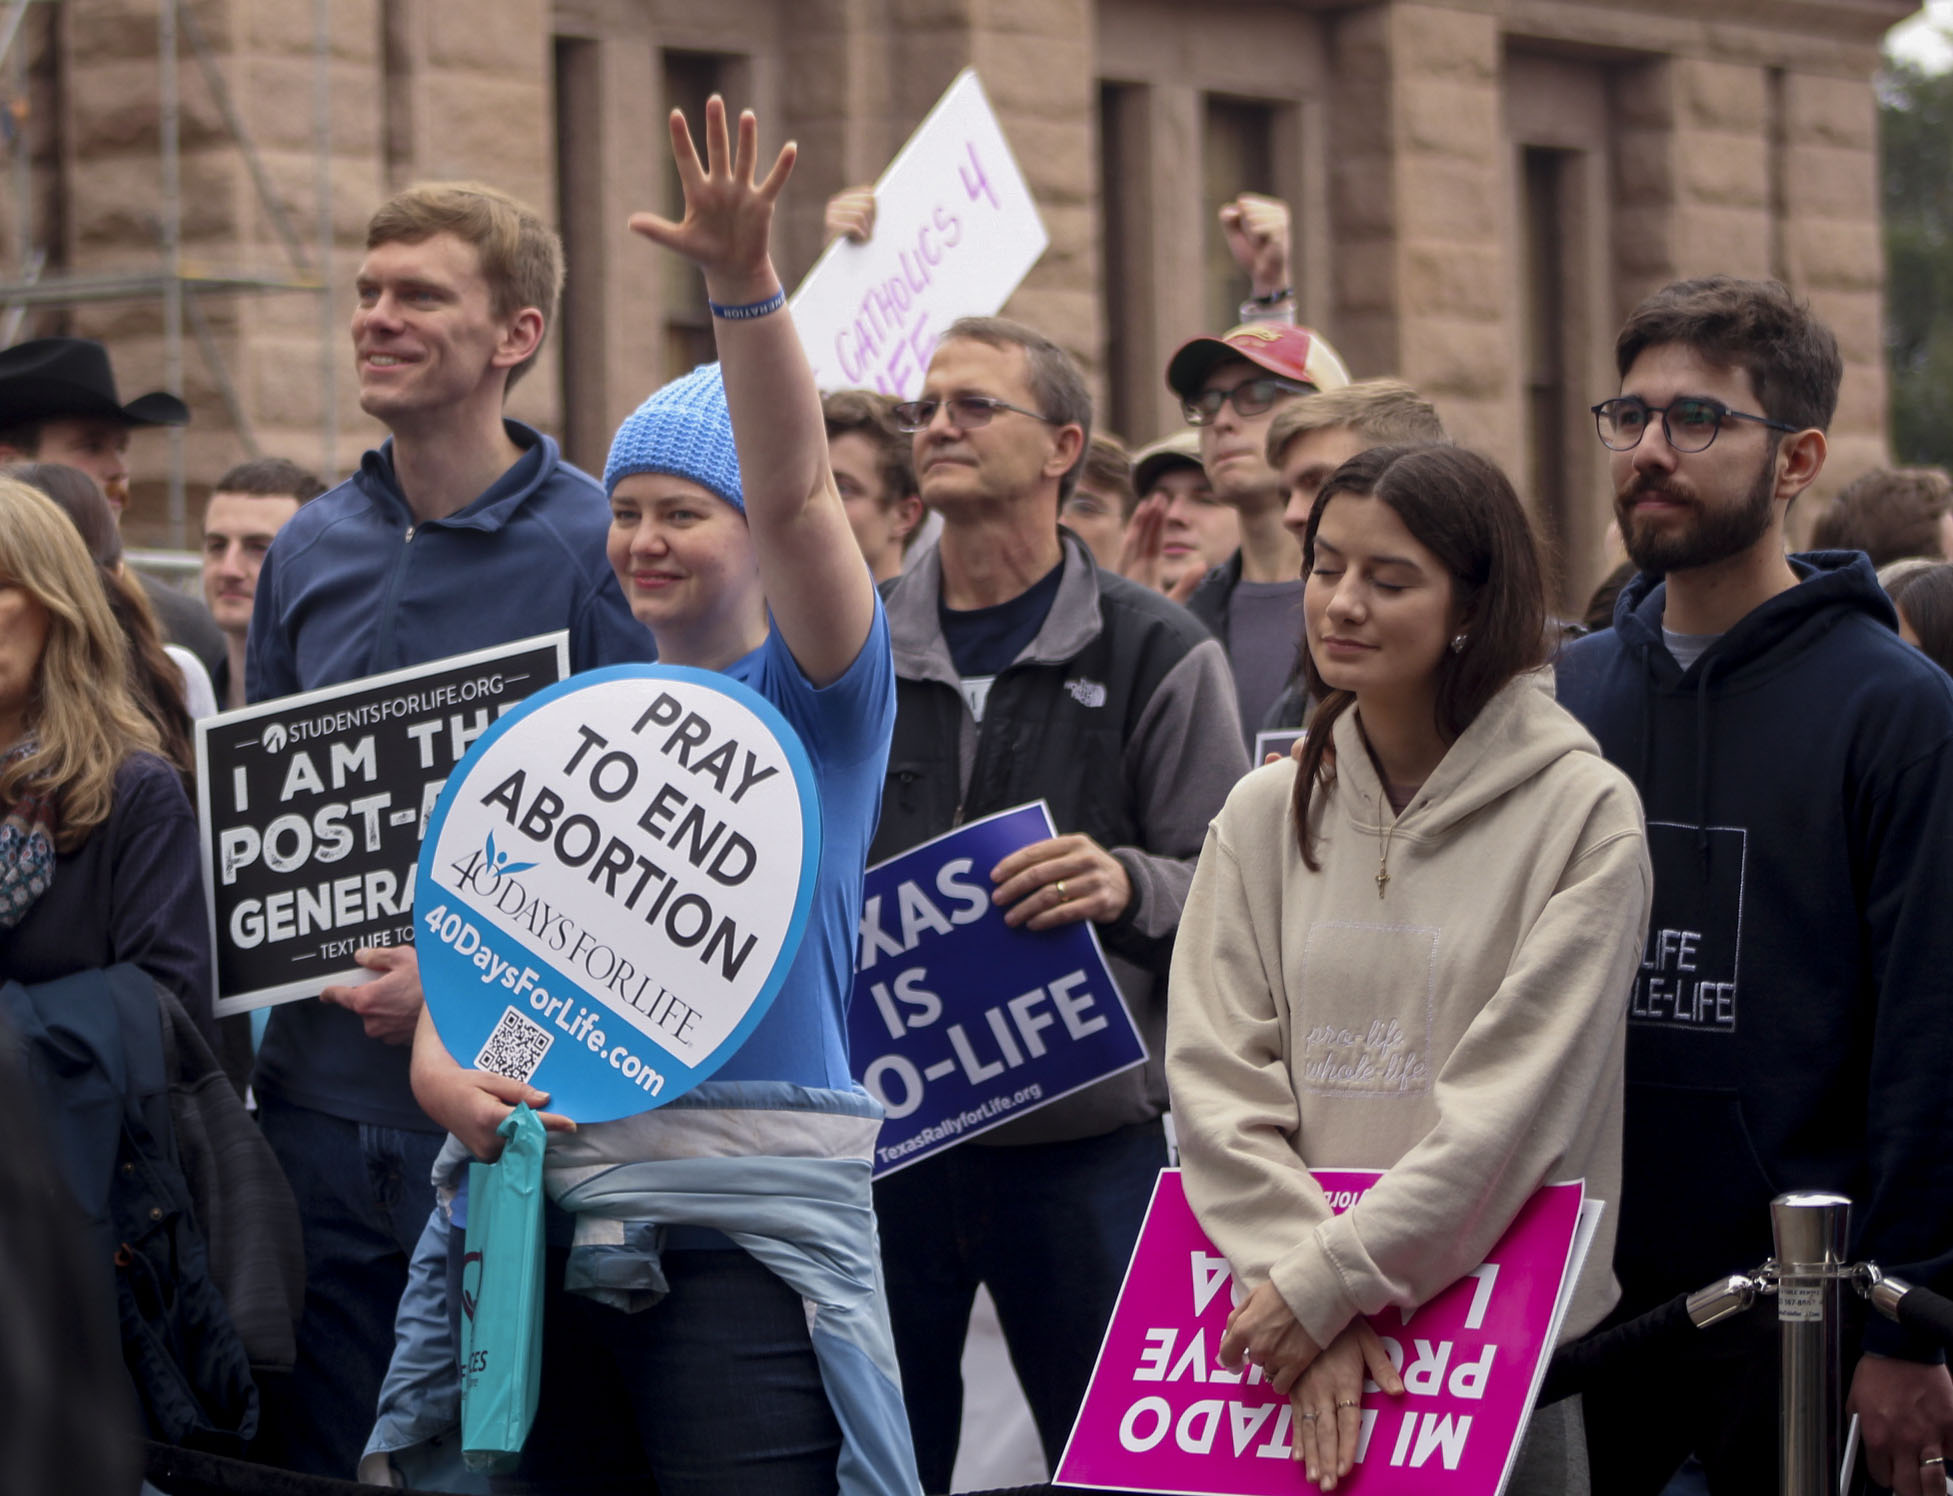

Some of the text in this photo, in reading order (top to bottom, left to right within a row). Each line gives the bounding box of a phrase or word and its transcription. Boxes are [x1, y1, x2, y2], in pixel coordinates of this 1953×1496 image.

[834, 141, 1001, 383] CATHOLICS 4
[234, 699, 525, 812] I AM TH
[289, 673, 504, 744] STUDENTSFORLIFE.ORG
[631, 691, 780, 804] PRAY
[563, 724, 758, 887] TO END
[480, 768, 759, 983] ABORTION
[854, 857, 991, 974] XAS
[320, 937, 356, 960] TEXT
[359, 930, 391, 949] LIFE
[424, 904, 666, 1098] 40DaysForLife.com
[450, 848, 703, 1045] 40 DAYS FOR LIFE
[1632, 977, 1735, 1023] LE-LIFE
[863, 969, 1109, 1120] O-LIFE
[870, 967, 943, 1039] IS
[1305, 1018, 1404, 1057] pro-life
[877, 1082, 1042, 1164] TexasRallyforLife.org
[1119, 1395, 1473, 1470] MI TADO
